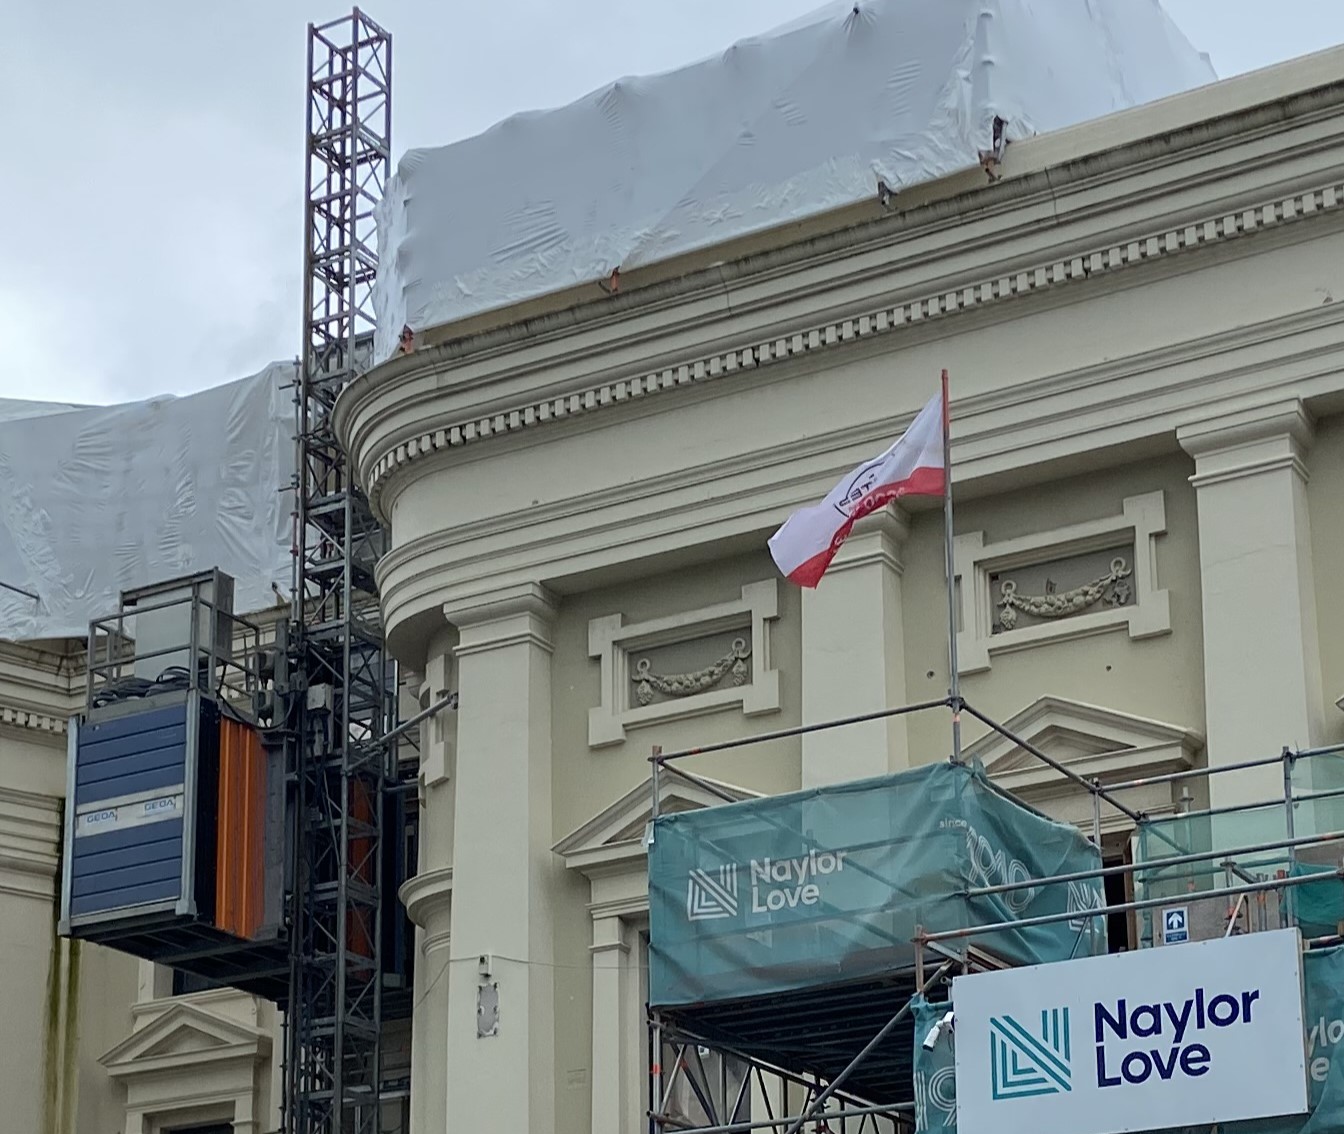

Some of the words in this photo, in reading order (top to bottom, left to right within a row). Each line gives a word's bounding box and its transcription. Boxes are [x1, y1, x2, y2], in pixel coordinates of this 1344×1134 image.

[939, 818, 968, 829] since
[750, 849, 848, 886] Naylor
[751, 882, 820, 914] Love
[1094, 988, 1260, 1045] Naylor
[1096, 1043, 1211, 1088] Love
[913, 1066, 957, 1132] 19
